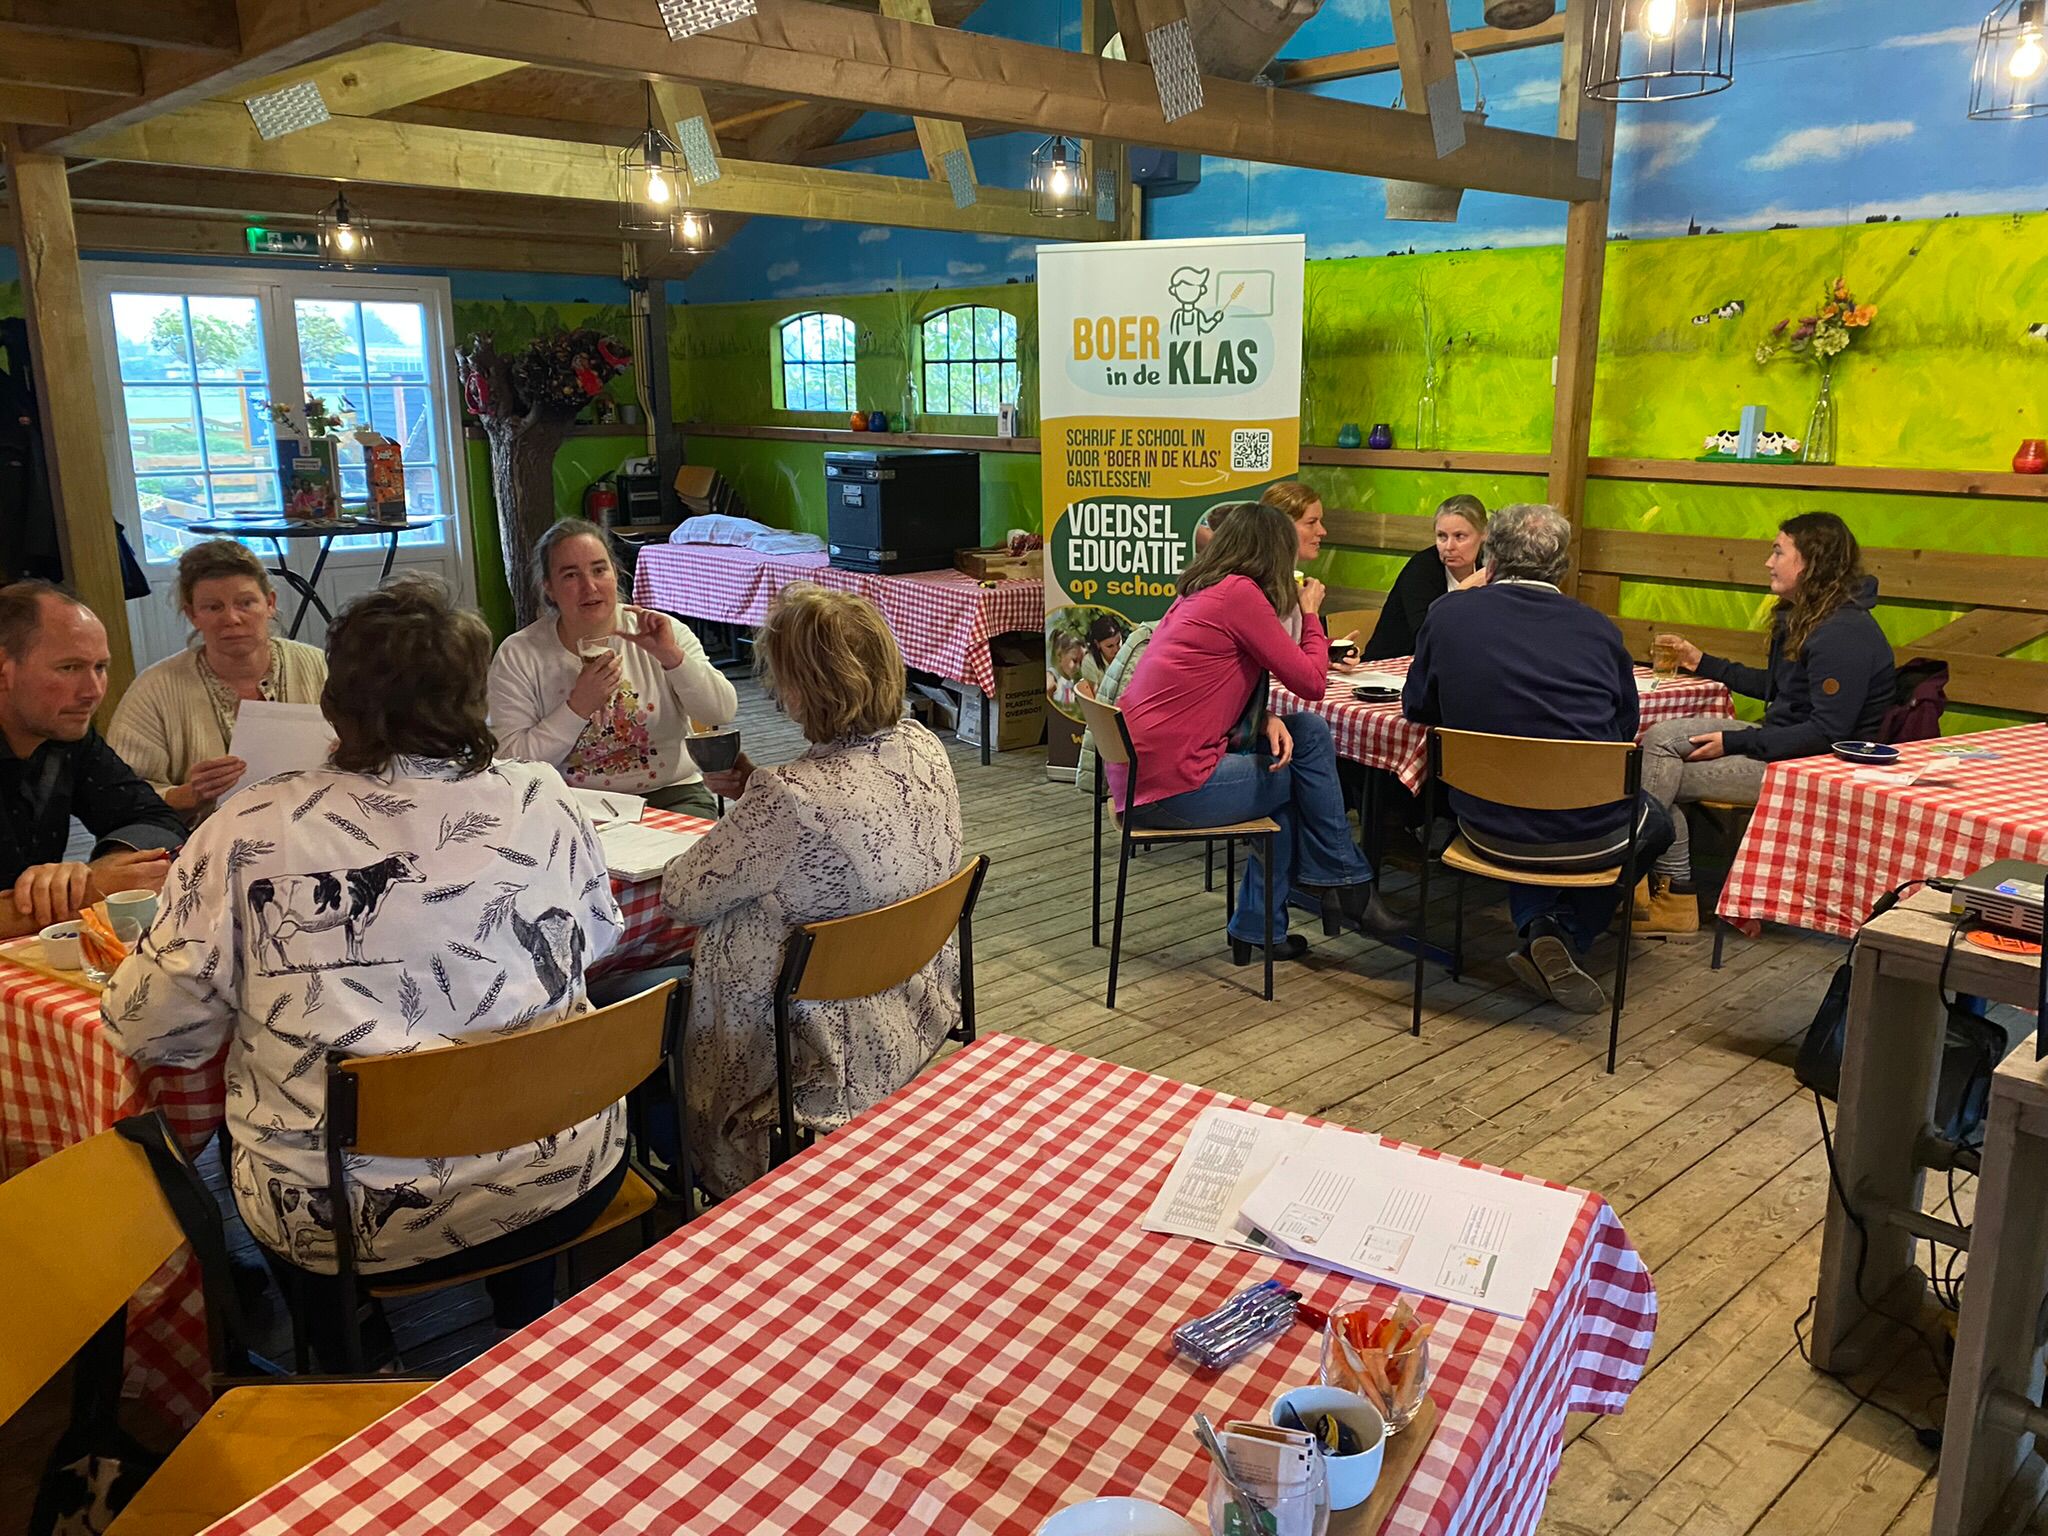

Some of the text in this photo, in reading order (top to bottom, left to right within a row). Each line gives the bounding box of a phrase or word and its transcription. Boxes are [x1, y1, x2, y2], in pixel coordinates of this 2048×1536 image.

[1073, 316, 1160, 361] BOER
[1106, 339, 1258, 386] in de KLAS
[1066, 429, 1205, 447] SCHRIJF JE SCHOOL IN
[1066, 450, 1100, 467] VOOR
[1145, 450, 1157, 467] IN
[1162, 450, 1178, 468] DE
[1067, 470, 1151, 488] GASTLESSEN!
[1067, 503, 1179, 539] VOEDSEL
[1068, 538, 1187, 575] EDUCATIE
[1069, 574, 1178, 600] op schoo
